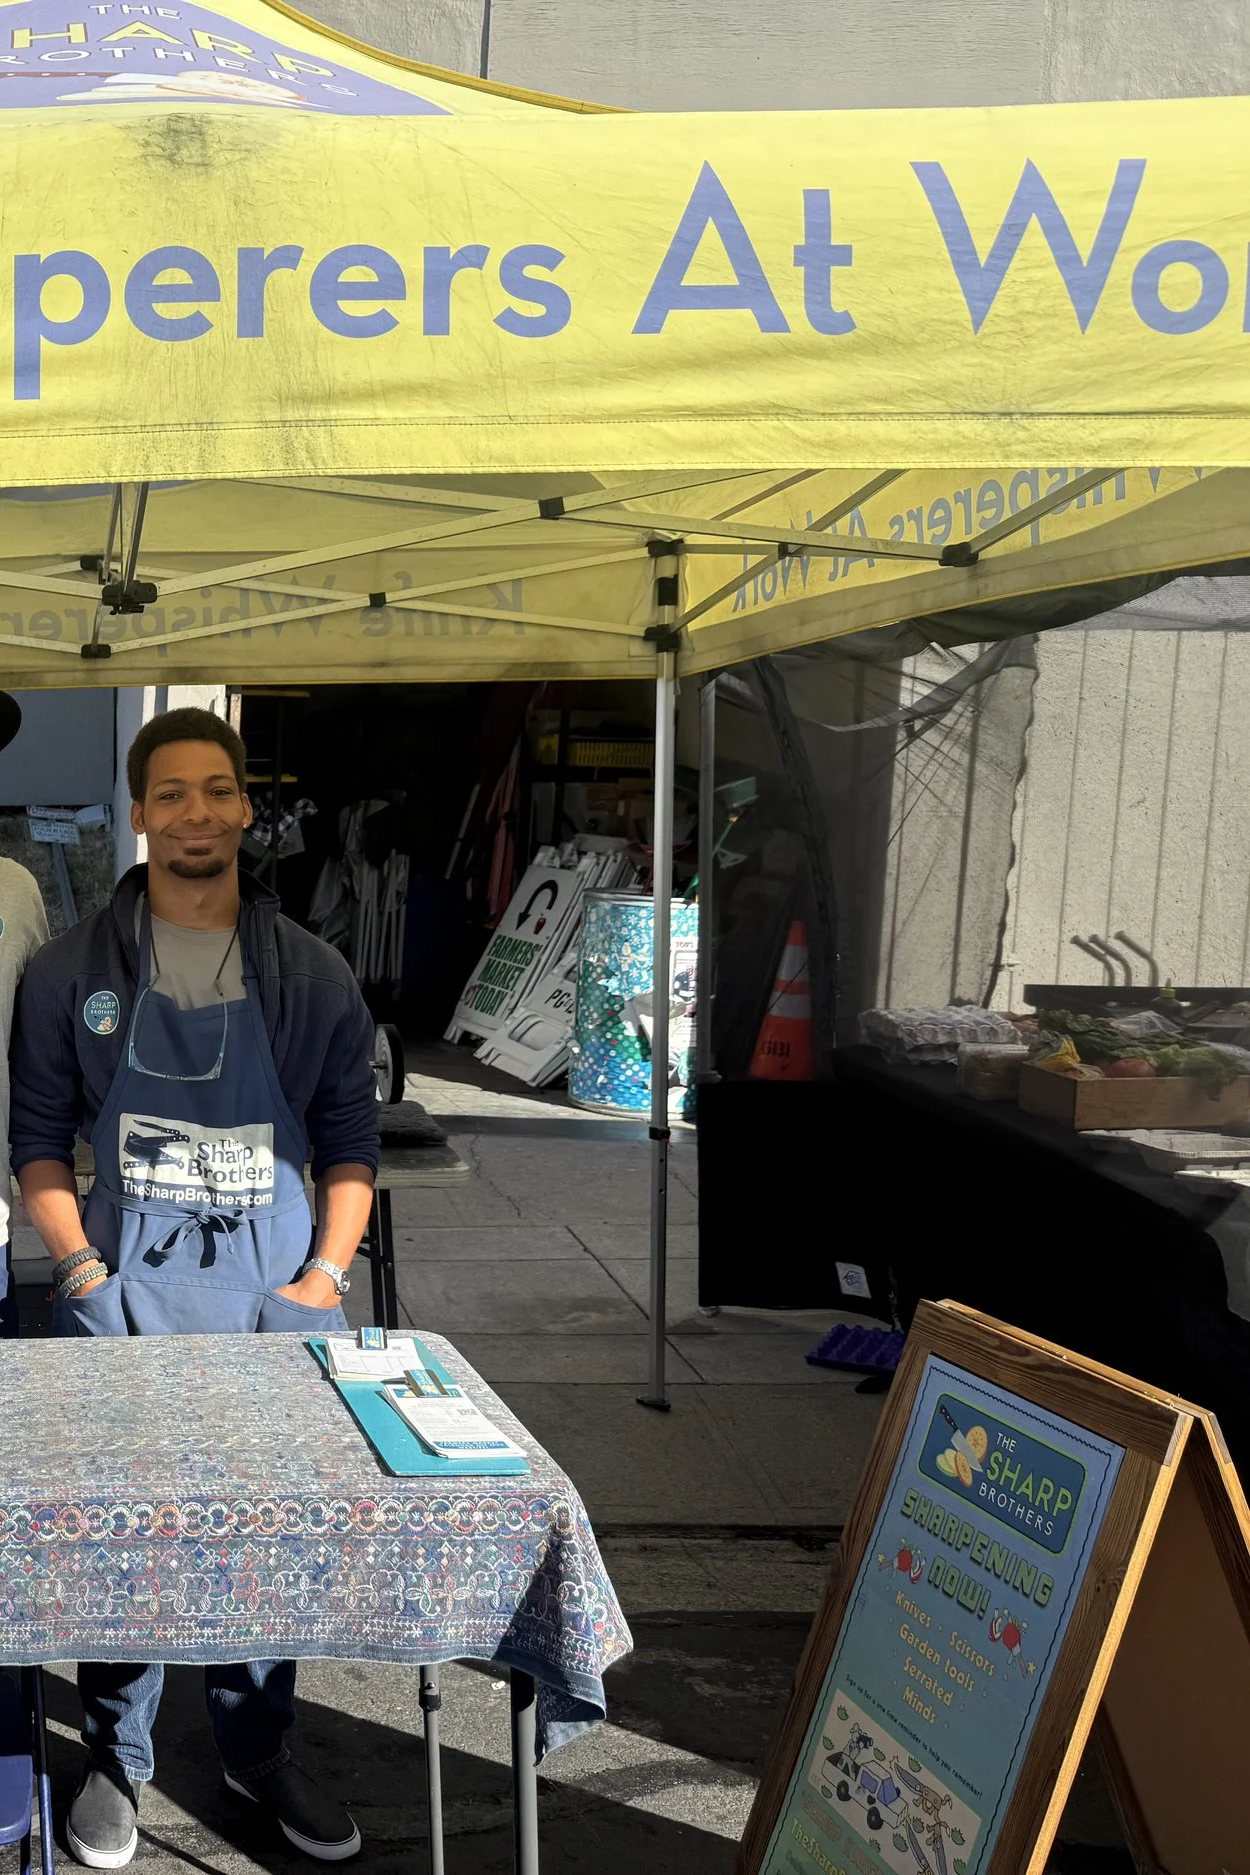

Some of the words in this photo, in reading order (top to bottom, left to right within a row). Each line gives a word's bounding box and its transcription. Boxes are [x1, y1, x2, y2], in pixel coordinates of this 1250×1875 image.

[88, 4, 183, 20] THE
[630, 159, 858, 336] At
[908, 158, 1250, 336] Wo
[477, 958, 526, 991] MARKET
[91, 1001, 116, 1010] SHARP
[469, 984, 508, 1016] TODAY
[197, 1141, 253, 1166] Sharp
[219, 1139, 239, 1148] The
[188, 1159, 273, 1183] Brothers
[997, 1432, 1017, 1453] THE
[986, 1451, 1072, 1517] SHARP
[978, 1482, 1054, 1536] BROTHERS
[901, 1487, 1055, 1608] SHARPENING
[895, 1590, 933, 1628] Knives
[949, 1631, 995, 1677] Scissors
[900, 1623, 940, 1666] Garden
[944, 1658, 975, 1692] tools
[902, 1656, 954, 1706] Serrated
[902, 1686, 937, 1725] Minds
[886, 1707, 898, 1724] time
[898, 1721, 922, 1744] reminder
[928, 1747, 940, 1762] help
[940, 1759, 951, 1772] you
[952, 1769, 983, 1801] remember!
